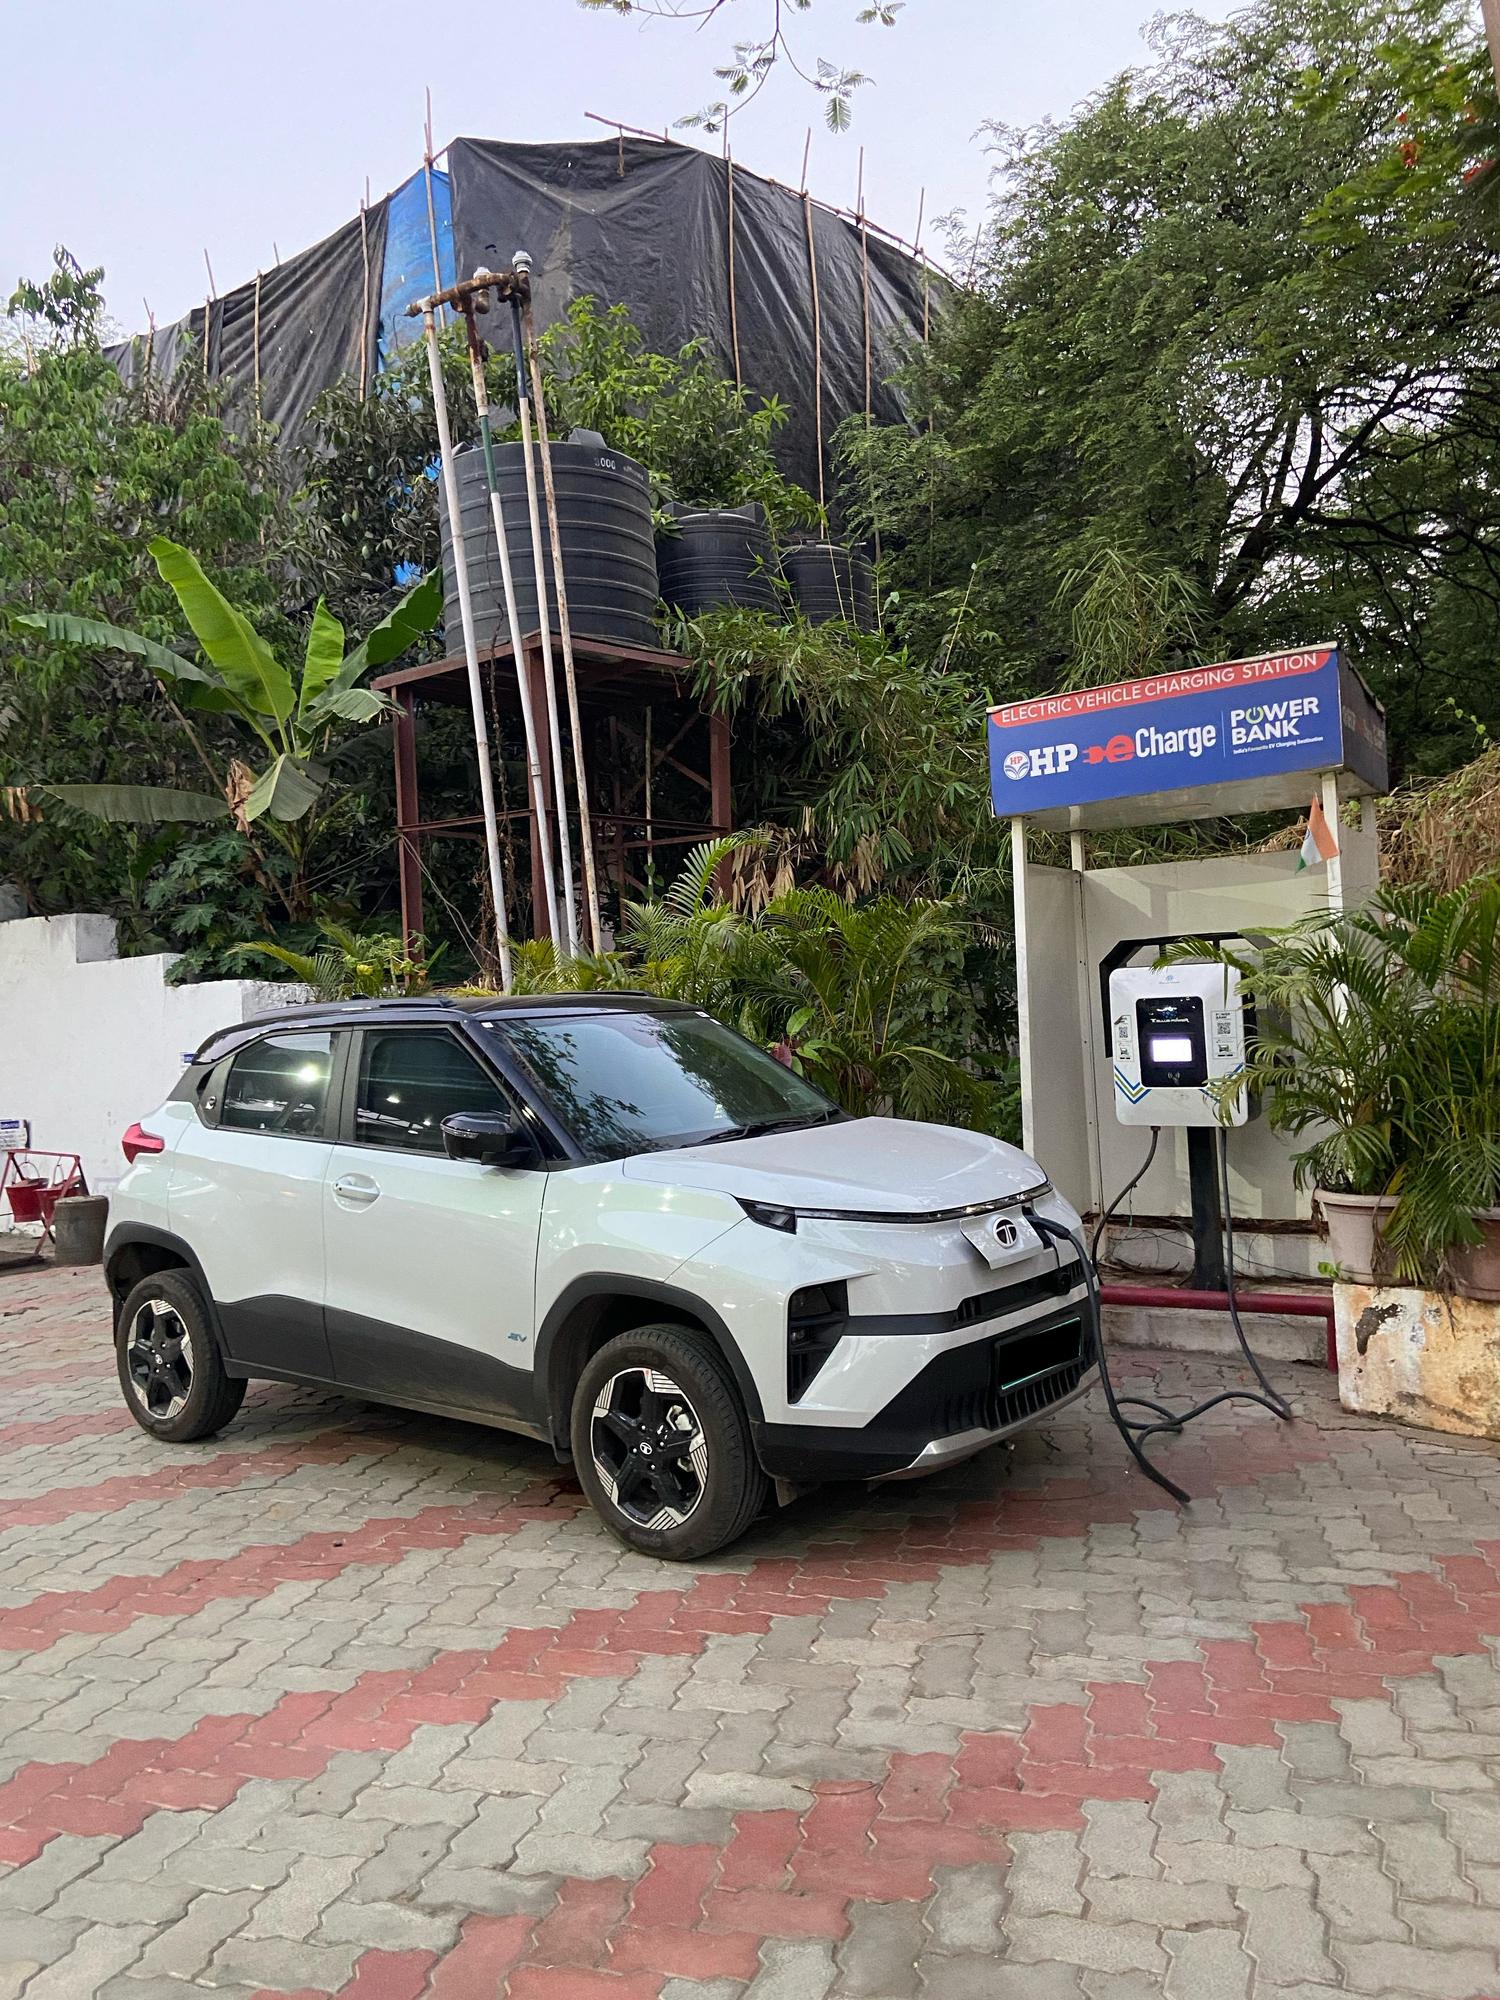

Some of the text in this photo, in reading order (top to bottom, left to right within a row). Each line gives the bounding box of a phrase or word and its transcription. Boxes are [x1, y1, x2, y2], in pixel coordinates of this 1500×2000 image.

[1001, 653, 1317, 723] ELECTRIC VEHICLE CHARGING STATION
[1231, 697, 1320, 728] POWER
[1232, 718, 1300, 745] BANK
[1010, 756, 1023, 765] HP
[1029, 743, 1079, 777] HP
